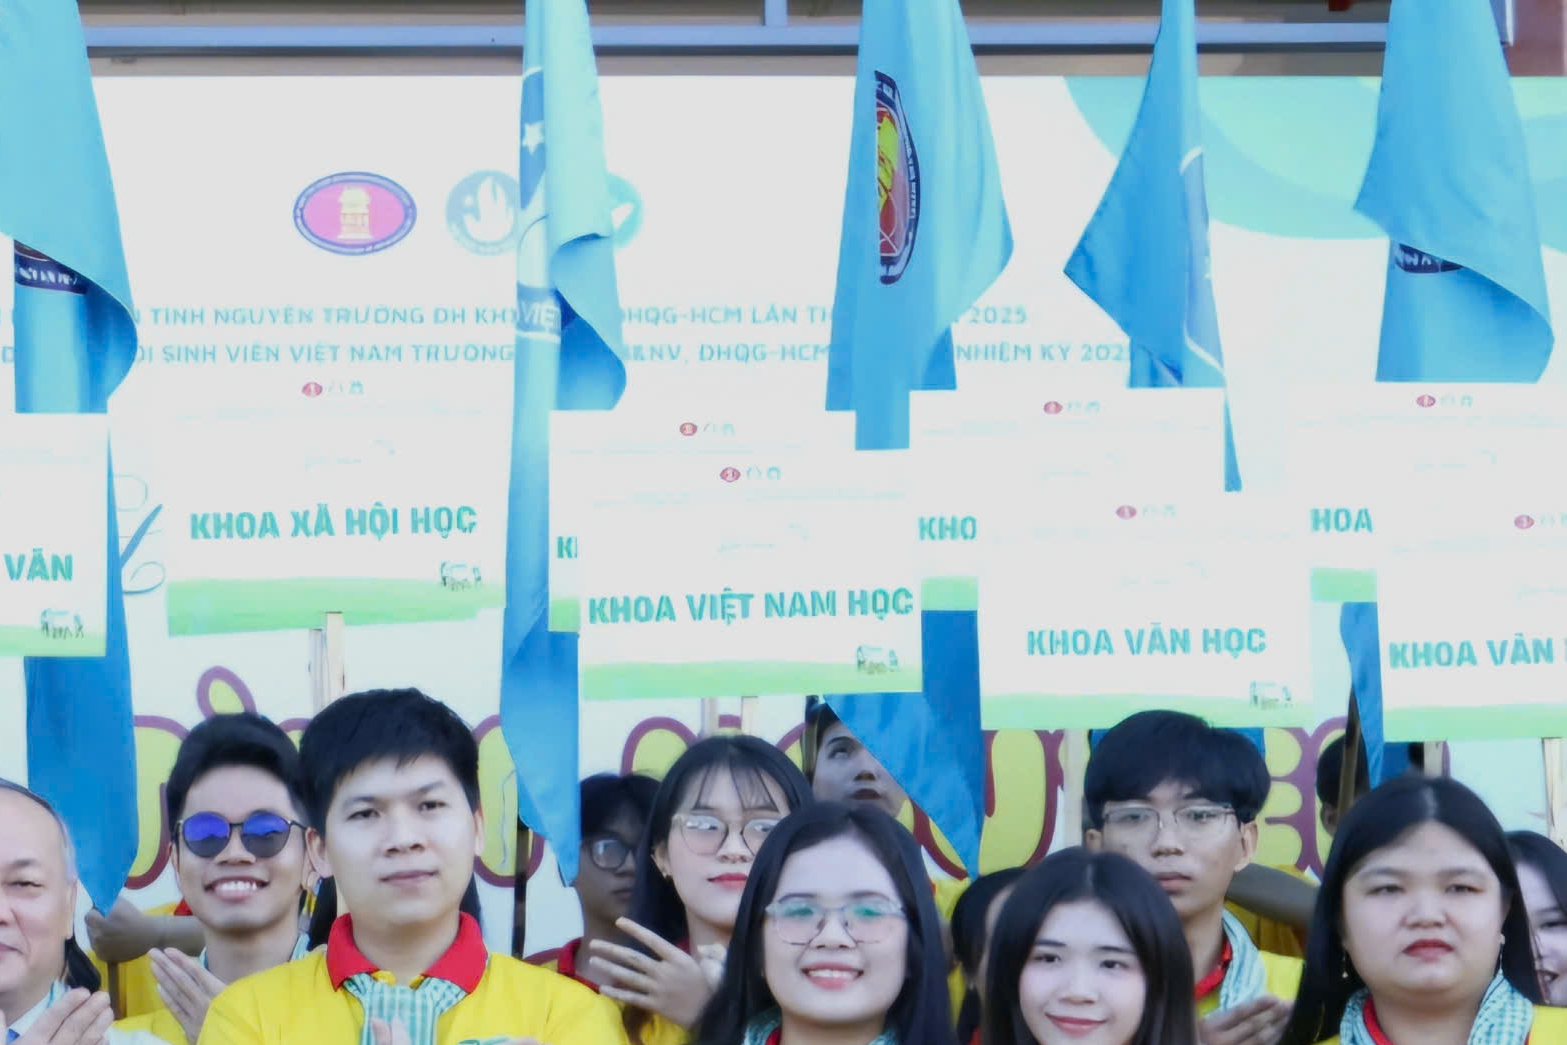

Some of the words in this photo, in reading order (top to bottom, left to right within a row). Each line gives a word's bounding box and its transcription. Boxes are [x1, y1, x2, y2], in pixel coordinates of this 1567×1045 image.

[161, 344, 217, 364] SINH
[349, 344, 403, 363] NAM
[190, 511, 280, 540] KHOA
[345, 501, 400, 541] HỘI
[410, 505, 477, 539] HỌC
[918, 515, 978, 541] KHO
[1310, 507, 1374, 533] HOA
[588, 594, 677, 625] KHOA
[685, 586, 755, 625] VIỆT
[764, 590, 837, 618] NAM
[848, 587, 914, 621] HỌC
[1027, 628, 1114, 656] KHOA
[1124, 622, 1191, 656] VĂN
[1202, 627, 1267, 659] HỌC
[1388, 640, 1478, 670] KHOA
